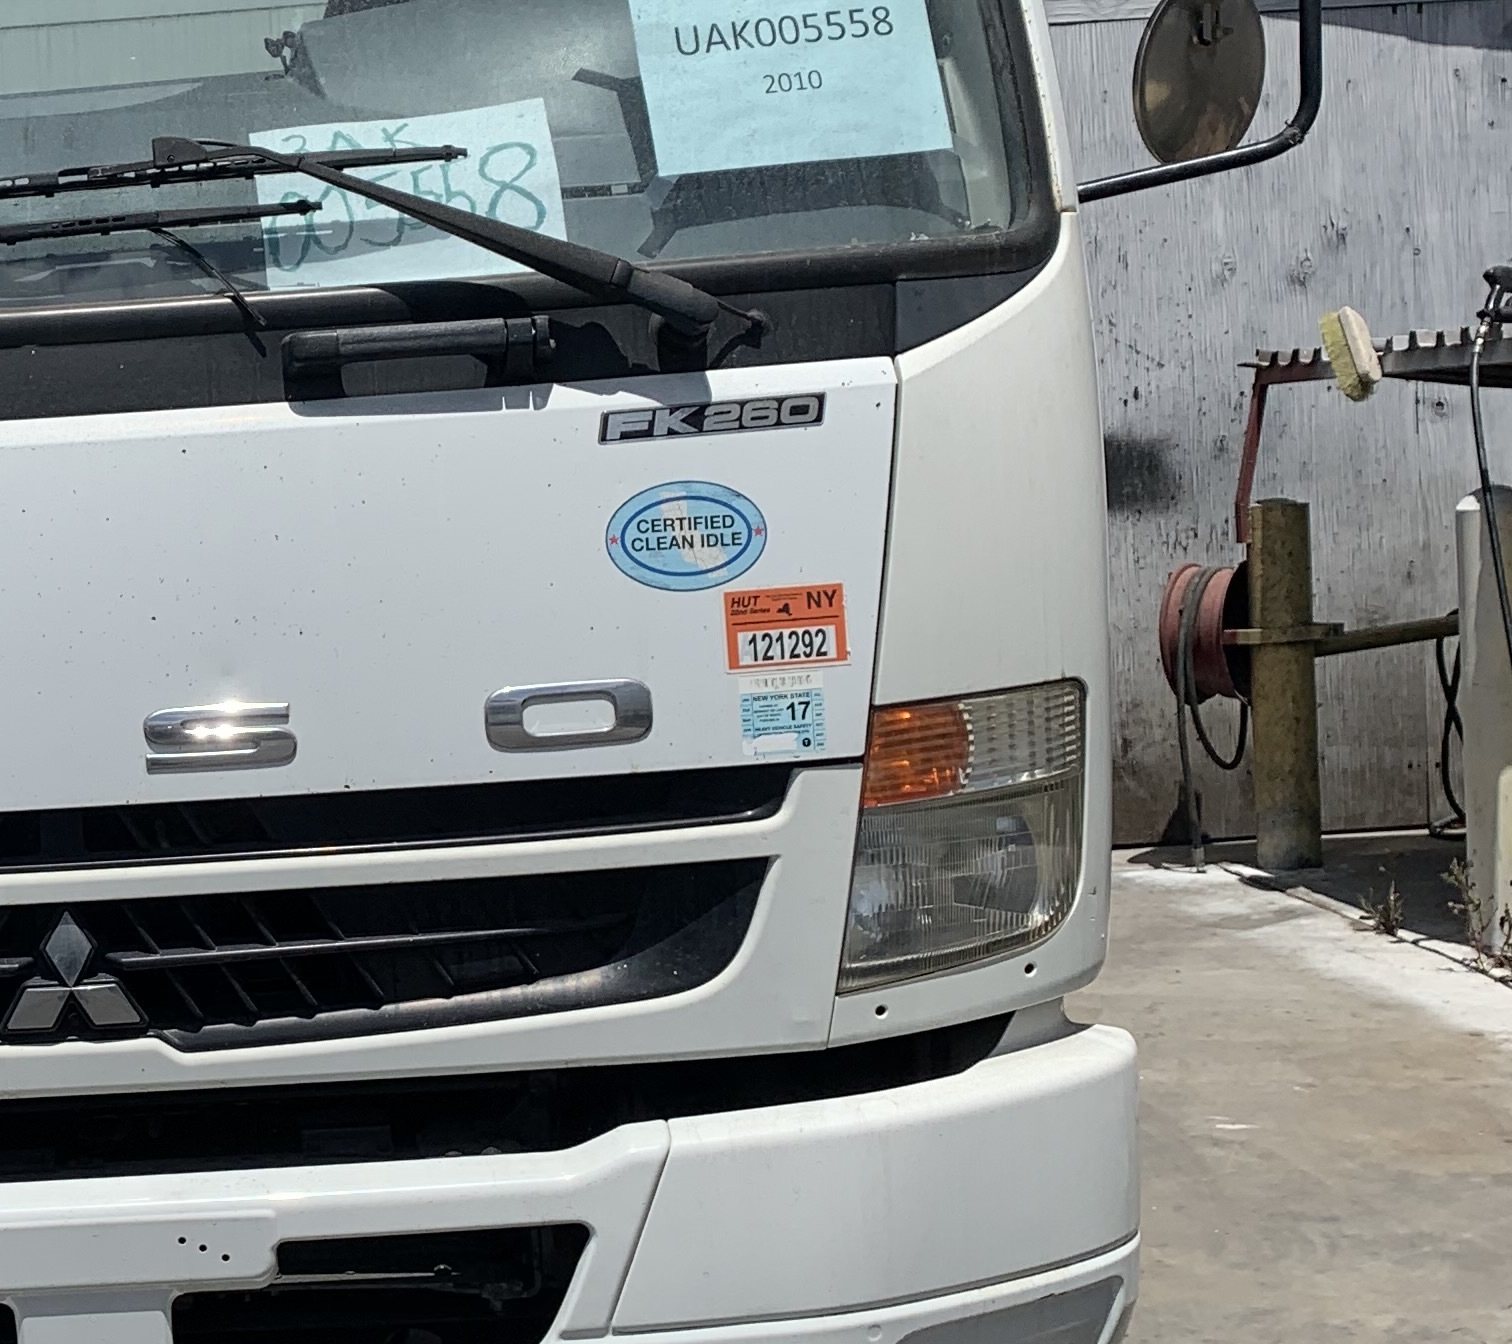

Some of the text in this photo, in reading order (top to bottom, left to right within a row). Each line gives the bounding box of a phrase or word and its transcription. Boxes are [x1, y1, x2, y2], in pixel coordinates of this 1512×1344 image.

[674, 5, 894, 56] UAK005558
[762, 69, 823, 94] 2010
[604, 395, 820, 441] FK260
[636, 514, 735, 534] CERTIFIED
[630, 531, 743, 552] CLEAN IDLE
[730, 595, 761, 608] HUT
[806, 589, 837, 609] NY
[748, 628, 828, 662] 121292
[786, 700, 811, 721] 17
